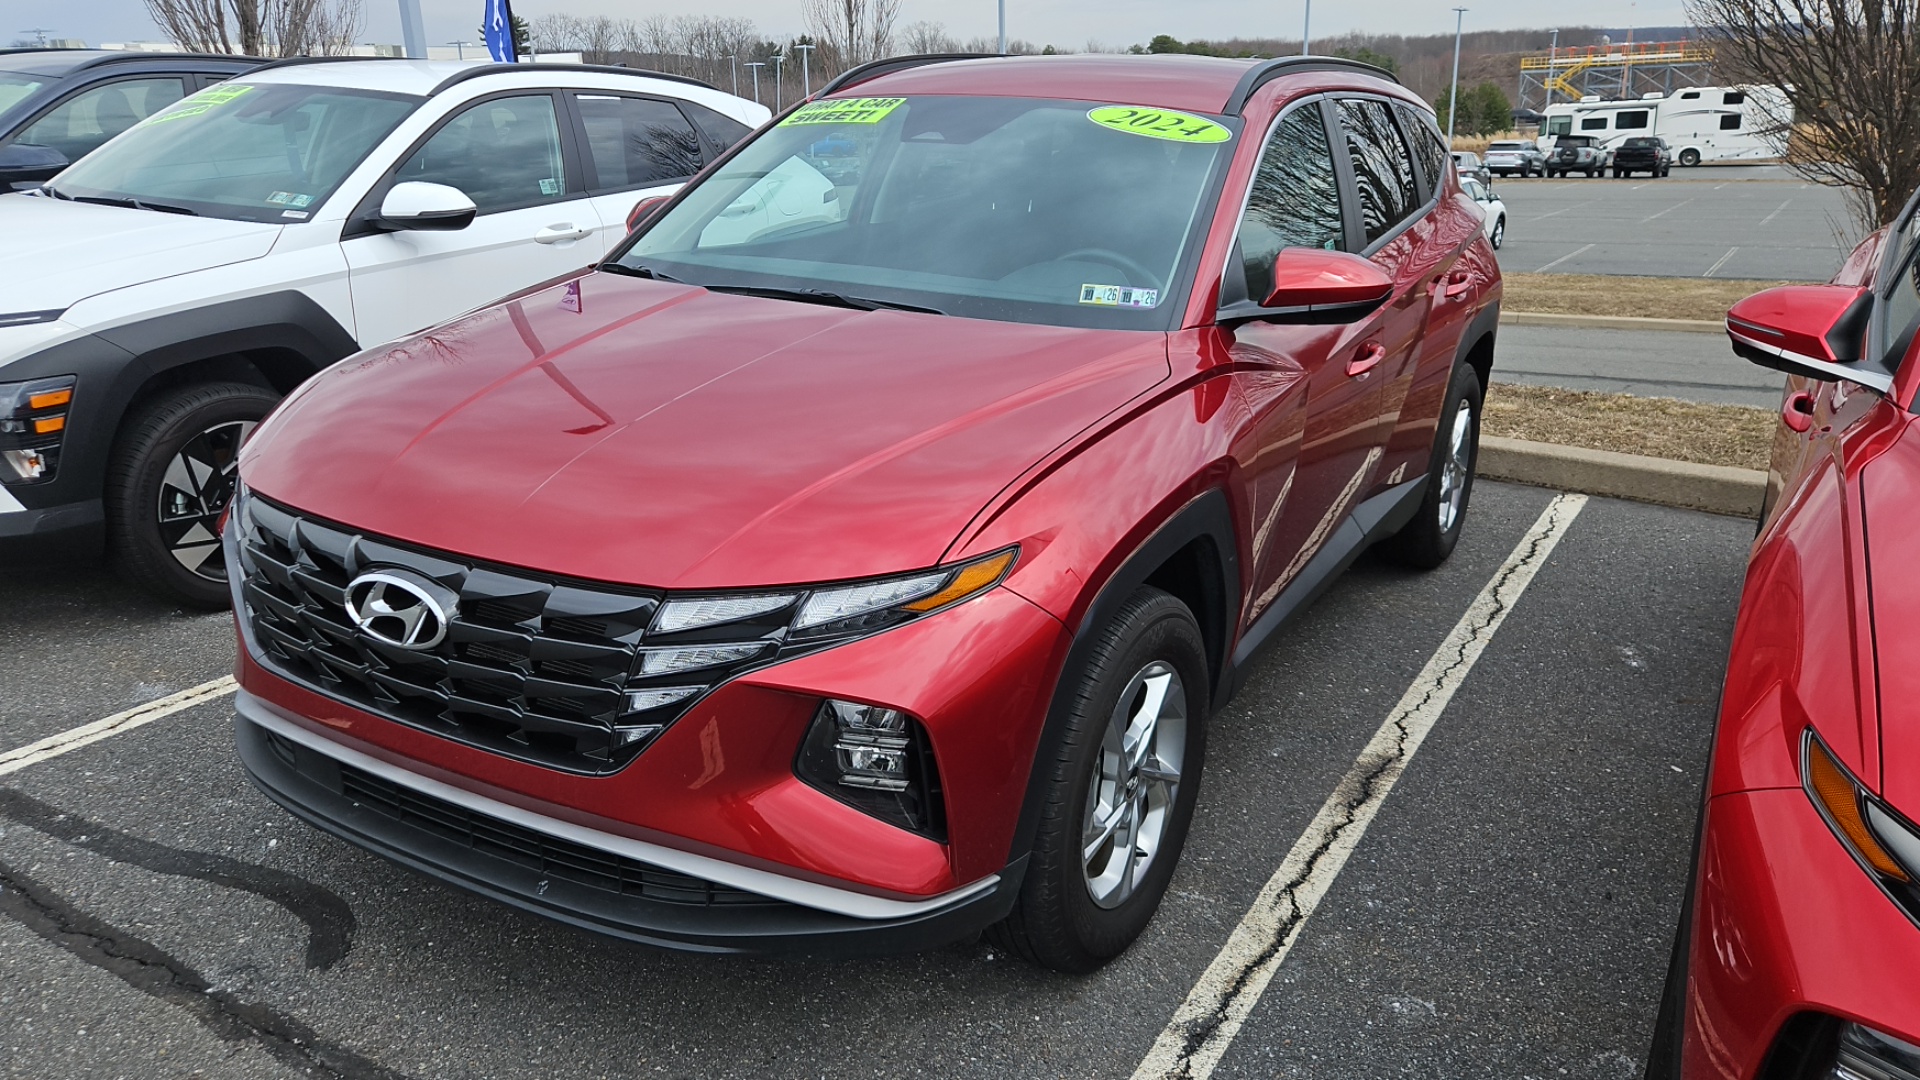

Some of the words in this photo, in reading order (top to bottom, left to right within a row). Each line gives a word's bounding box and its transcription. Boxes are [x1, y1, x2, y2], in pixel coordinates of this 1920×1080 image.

[860, 98, 901, 108] CAR
[788, 110, 878, 123] SWEET!
[1103, 110, 1214, 136] 2024
[1106, 287, 1118, 301] 26
[1144, 291, 1156, 305] 26
